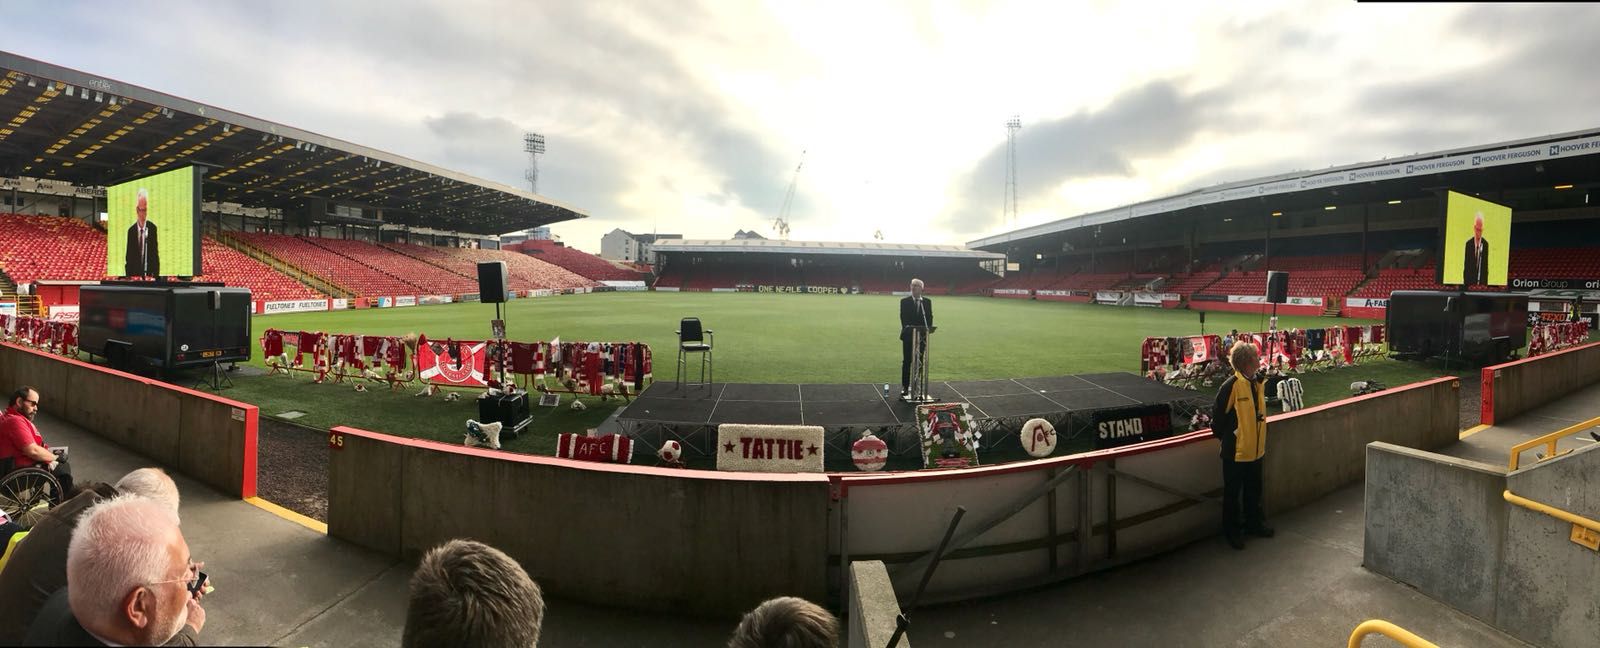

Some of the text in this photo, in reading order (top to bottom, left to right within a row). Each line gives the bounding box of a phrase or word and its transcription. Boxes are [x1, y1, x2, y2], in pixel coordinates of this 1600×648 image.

[1560, 140, 1600, 153] HOOVER FE
[1481, 149, 1541, 163] HOOVER FERGUSON
[1414, 159, 1465, 171] HOOVER FERGUSON
[758, 285, 838, 295] ONE NEALE COOPER
[1513, 279, 1569, 289] Orion Group
[330, 434, 343, 447] 45
[579, 442, 606, 456] AFC
[740, 436, 804, 460] TATTIE
